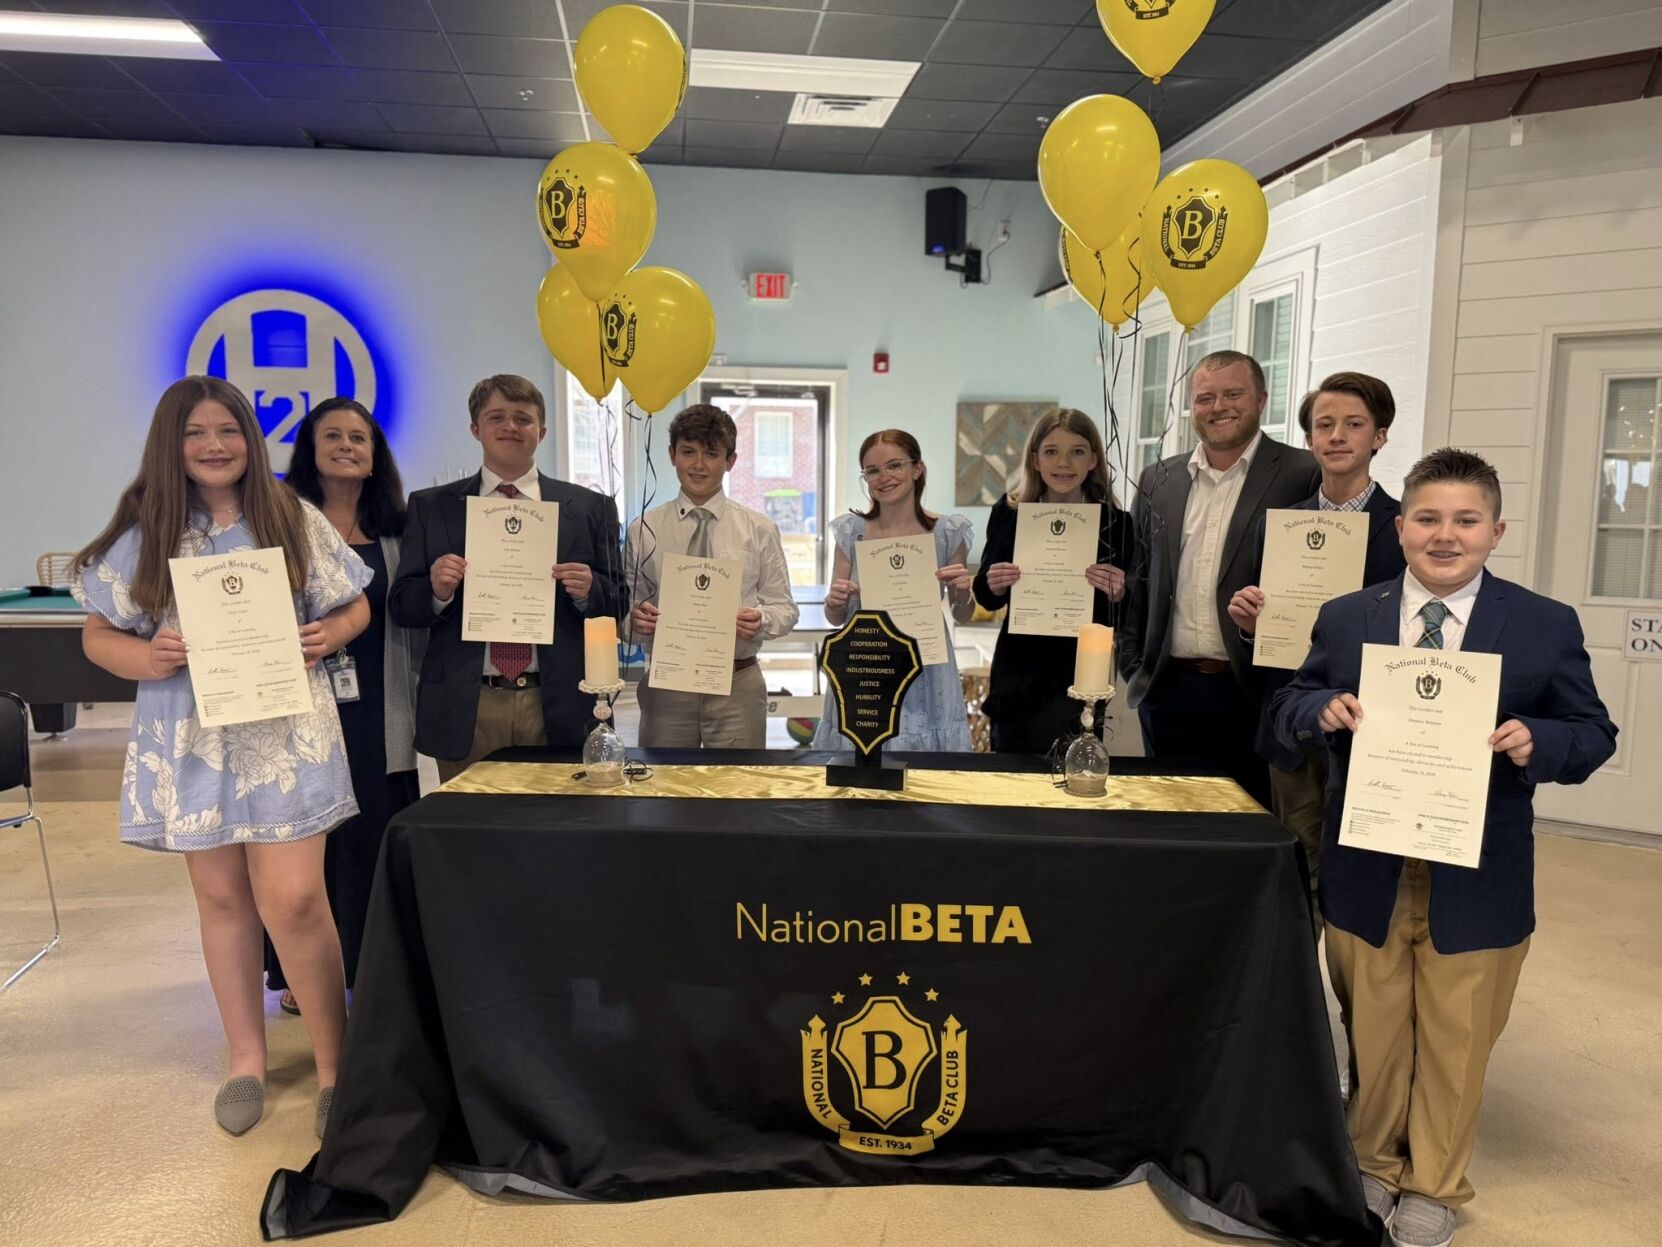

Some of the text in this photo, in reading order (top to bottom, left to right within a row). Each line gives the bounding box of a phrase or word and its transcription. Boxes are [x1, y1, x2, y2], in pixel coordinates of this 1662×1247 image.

[551, 190, 565, 218] B
[1162, 217, 1170, 252] NATIONAL
[1182, 210, 1203, 239] B
[1217, 219, 1225, 237] CLUB
[756, 274, 785, 298] EXIT
[608, 314, 618, 340] B
[1284, 517, 1314, 533] National
[192, 561, 227, 582] National
[1631, 618, 1662, 633] ST
[1384, 656, 1477, 684] National Beta Club
[862, 1031, 907, 1090] B
[811, 1049, 832, 1119] NATIONAL
[936, 1050, 958, 1126] BETA CLUB
[859, 1136, 912, 1150] EST. 1934
